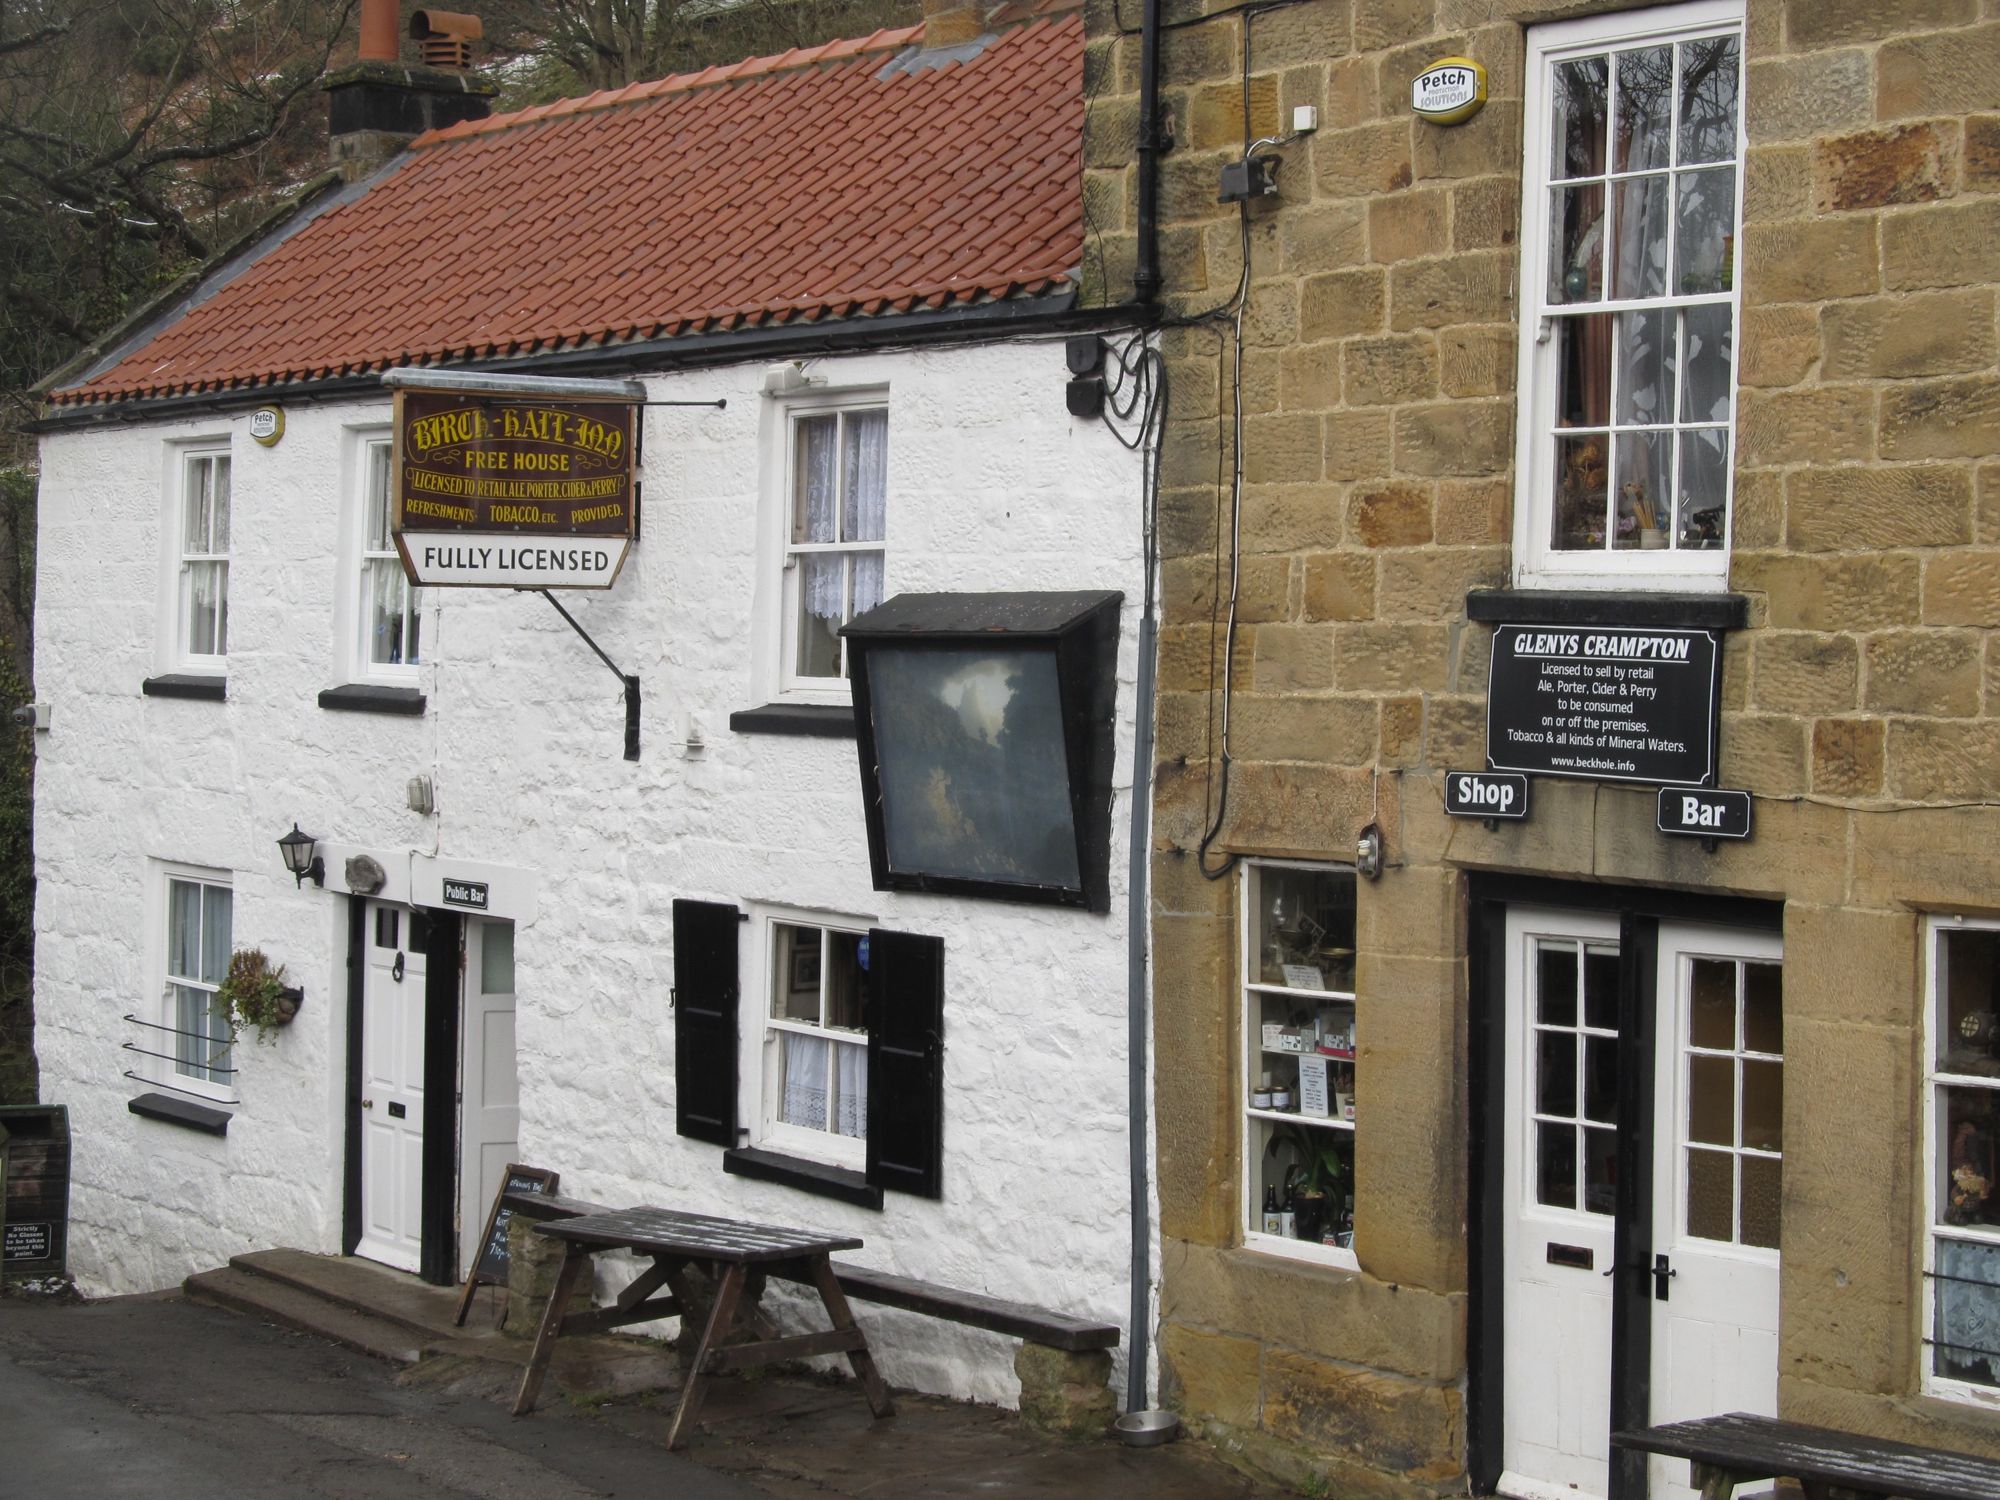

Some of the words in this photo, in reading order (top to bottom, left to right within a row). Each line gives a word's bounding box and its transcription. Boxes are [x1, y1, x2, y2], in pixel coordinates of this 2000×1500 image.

[1422, 70, 1466, 92] Petch
[1420, 91, 1468, 108] SOLUTIONS
[465, 450, 508, 469] FREE
[513, 452, 570, 472] HOUSE
[414, 471, 463, 495] LICENSED
[464, 479, 475, 495] TO
[477, 480, 508, 498] RETAIL
[509, 481, 525, 498] ALE
[571, 503, 624, 524] PROVIDED.
[424, 546, 492, 569] FULLY
[498, 548, 609, 571] LICENSED
[1513, 633, 1580, 655] GLENYS
[1583, 635, 1691, 659] CRAMPTON
[1541, 662, 1581, 676] Licensed
[1583, 664, 1594, 677] to
[1595, 664, 1611, 678] sell
[1613, 665, 1626, 681] by
[1628, 666, 1654, 680] retail
[1537, 679, 1555, 693] Ale,
[1557, 680, 1589, 695] Porter,
[1592, 681, 1617, 695] Cider
[1619, 683, 1628, 696] &
[1630, 684, 1657, 700] Perry
[1557, 698, 1568, 710] to
[1570, 698, 1582, 711] be
[1584, 700, 1633, 714] consumed
[1541, 716, 1553, 727] on
[1555, 717, 1565, 728] or
[1568, 716, 1582, 728] off
[1583, 716, 1599, 729] the
[1602, 719, 1649, 732] premises.
[1507, 728, 1544, 743] Tobacco
[1546, 731, 1554, 744] &
[1556, 731, 1567, 745] all
[1569, 733, 1594, 747] kinds
[1596, 734, 1607, 747] of
[1609, 735, 1645, 750] Mineral
[1648, 738, 1687, 753] Waters.
[1551, 756, 1636, 772] www.beckhole.info
[1458, 776, 1514, 812] Shop
[1681, 795, 1726, 827] Bar
[446, 885, 468, 900] Public
[470, 888, 484, 902] Bar
